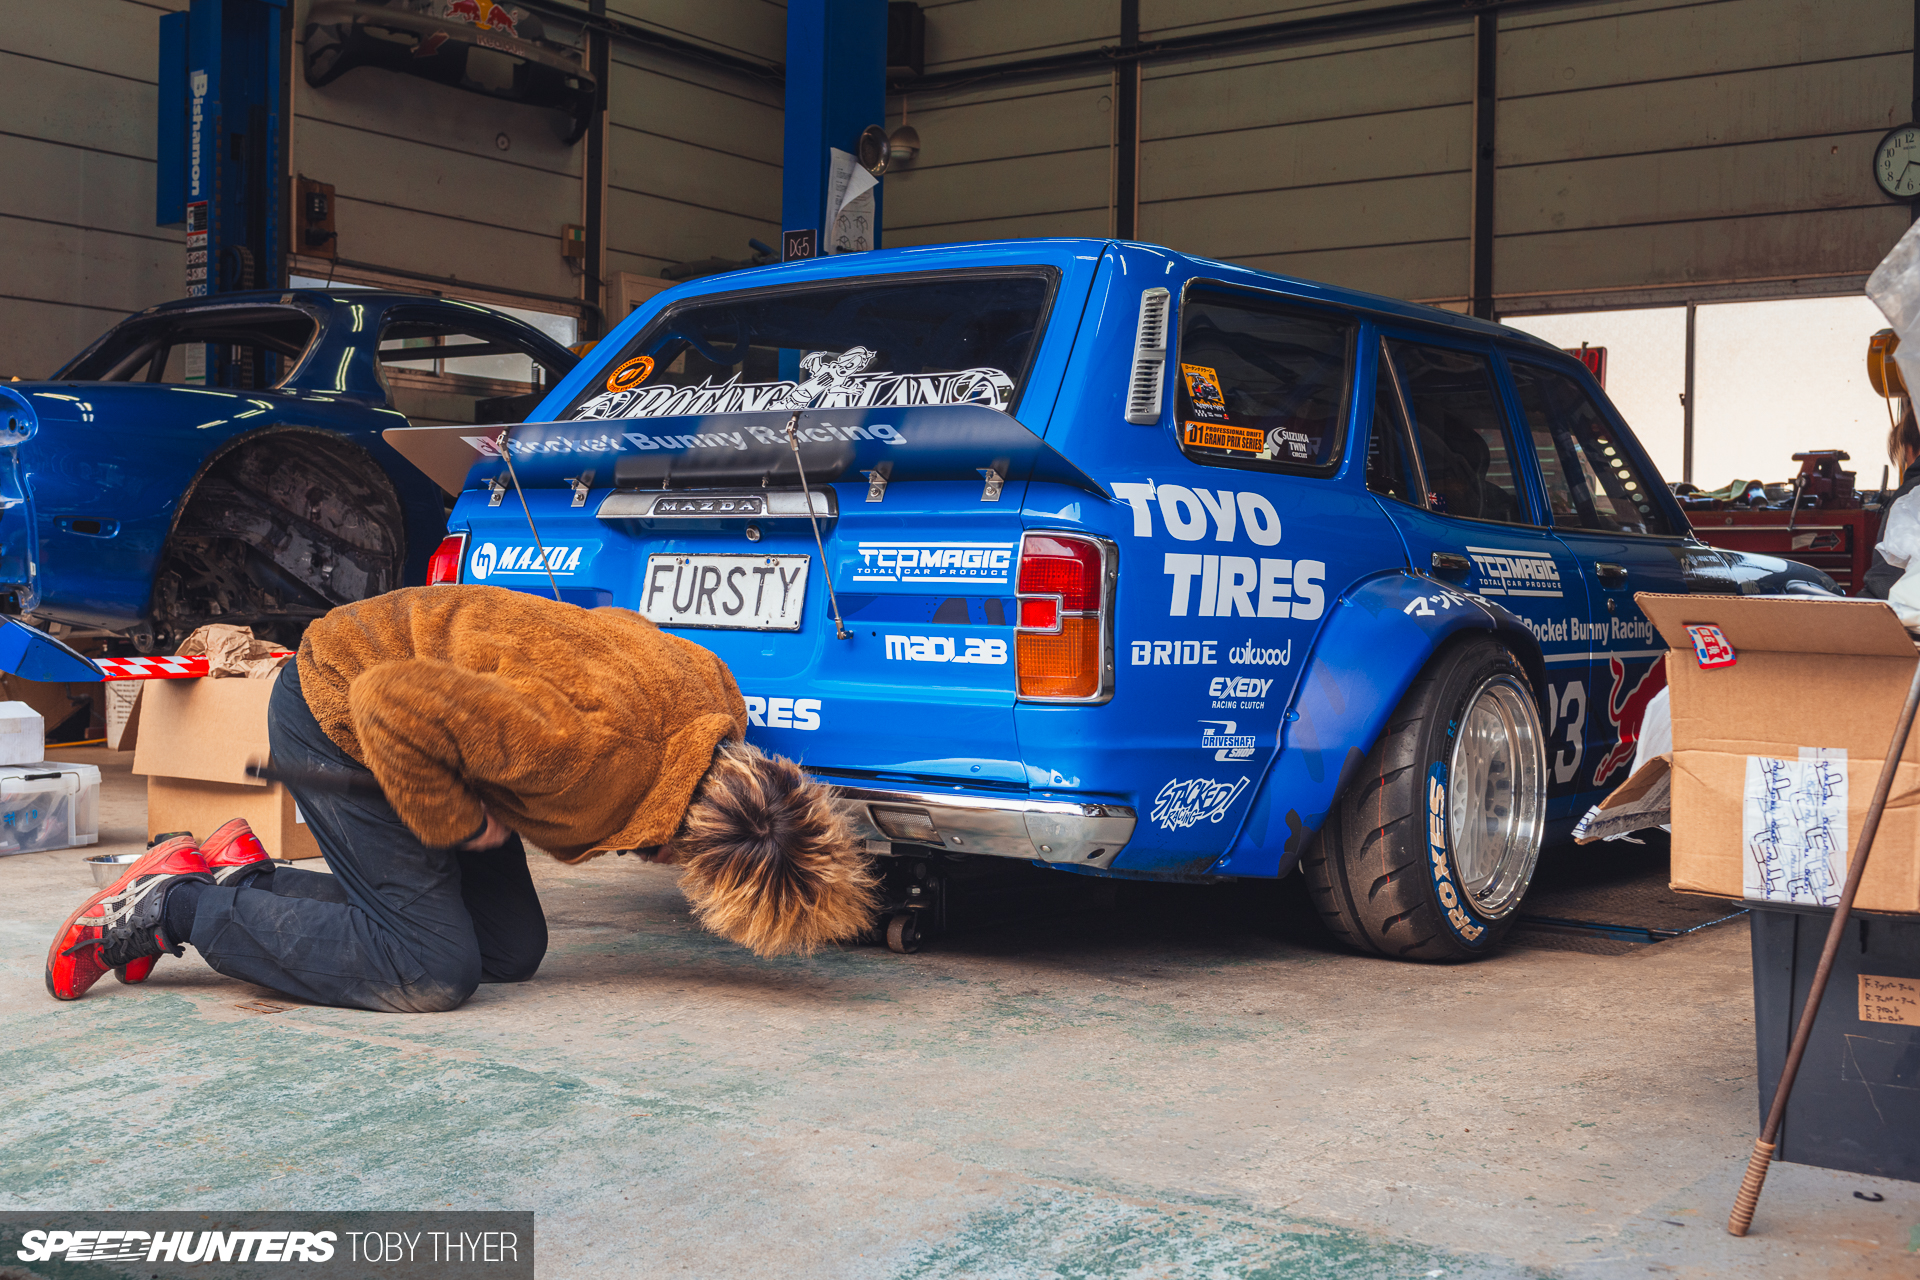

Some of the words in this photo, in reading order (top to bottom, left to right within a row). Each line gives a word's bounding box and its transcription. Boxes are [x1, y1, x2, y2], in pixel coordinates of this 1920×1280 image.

[192, 74, 208, 196] Bishamon
[1905, 132, 1915, 144] 12
[1894, 138, 1902, 148] 11
[1886, 147, 1895, 158] 10
[1884, 159, 1891, 170] 9
[1887, 171, 1894, 182] 8
[1907, 180, 1914, 191] 6
[622, 432, 748, 450] Bunny
[744, 422, 907, 445] Racing
[1188, 425, 1204, 444] D1
[1205, 426, 1245, 437] PROFESSIONAL
[1246, 430, 1262, 438] DRIFT
[1281, 430, 1310, 443] SUZUKA
[1204, 433, 1225, 446] GRAND
[1226, 434, 1240, 448] PRIX
[1241, 436, 1262, 450] SERIES
[1288, 441, 1307, 452] TWIN
[660, 501, 755, 511] MAZDA
[1109, 481, 1282, 547] TOYO
[497, 546, 583, 571] MAZDA
[1163, 552, 1326, 621] TIRES
[1478, 578, 1502, 586] TOTAL
[1506, 579, 1523, 587] CAR
[1525, 581, 1562, 589] PRODUCE
[647, 564, 801, 618] FURSTY
[1570, 617, 1610, 646] Bunny
[1611, 616, 1653, 645] Racing
[1131, 640, 1218, 666] BRIDE
[1228, 638, 1291, 666] wilwood
[1208, 676, 1274, 699] EXEDY
[1211, 701, 1237, 709] RACING
[1240, 701, 1265, 709] CLUTCH
[742, 695, 822, 731] RES
[1203, 728, 1216, 736] THE
[1202, 736, 1255, 747] DRIVESHAFT
[1228, 748, 1256, 758] SHOP
[1429, 775, 1484, 942] PROXES
